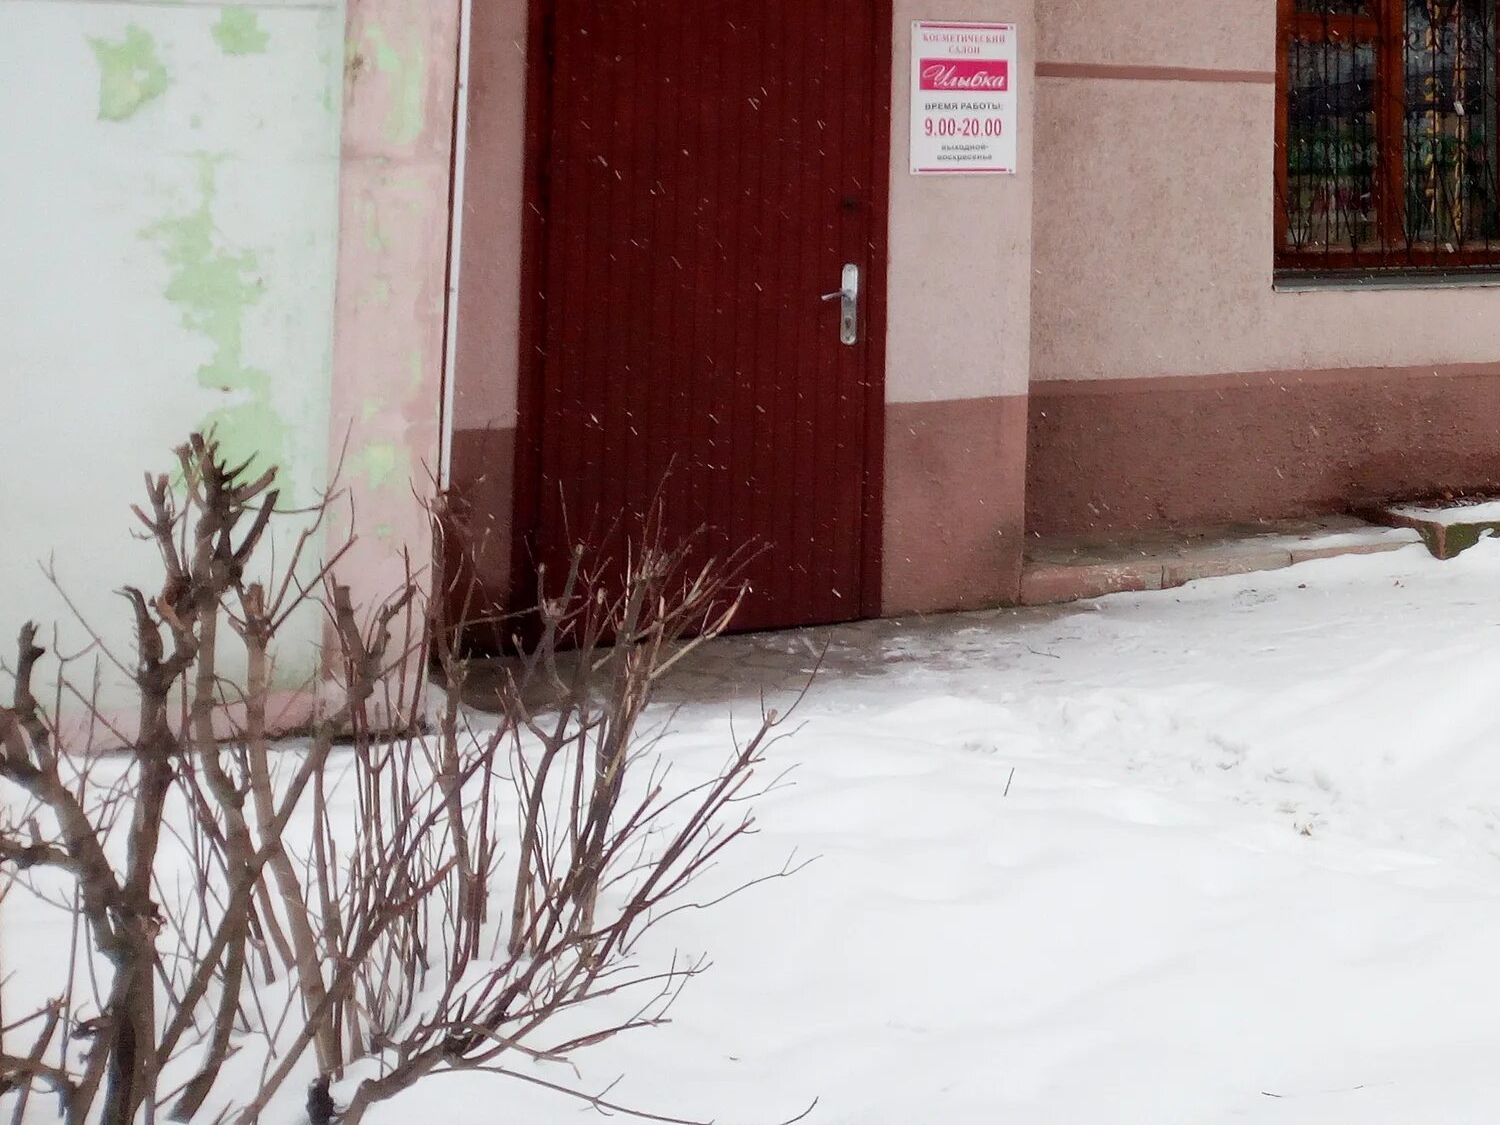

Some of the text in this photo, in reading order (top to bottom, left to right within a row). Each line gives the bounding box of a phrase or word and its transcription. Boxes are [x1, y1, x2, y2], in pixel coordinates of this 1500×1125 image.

[923, 33, 1005, 44] КОСМЕТИЧЕСКИЙ
[948, 46, 980, 54] САЛОН
[923, 64, 1004, 87] Улыбка
[925, 102, 958, 110] ВРЕМЯ
[925, 118, 1002, 136] 9.00-20.00
